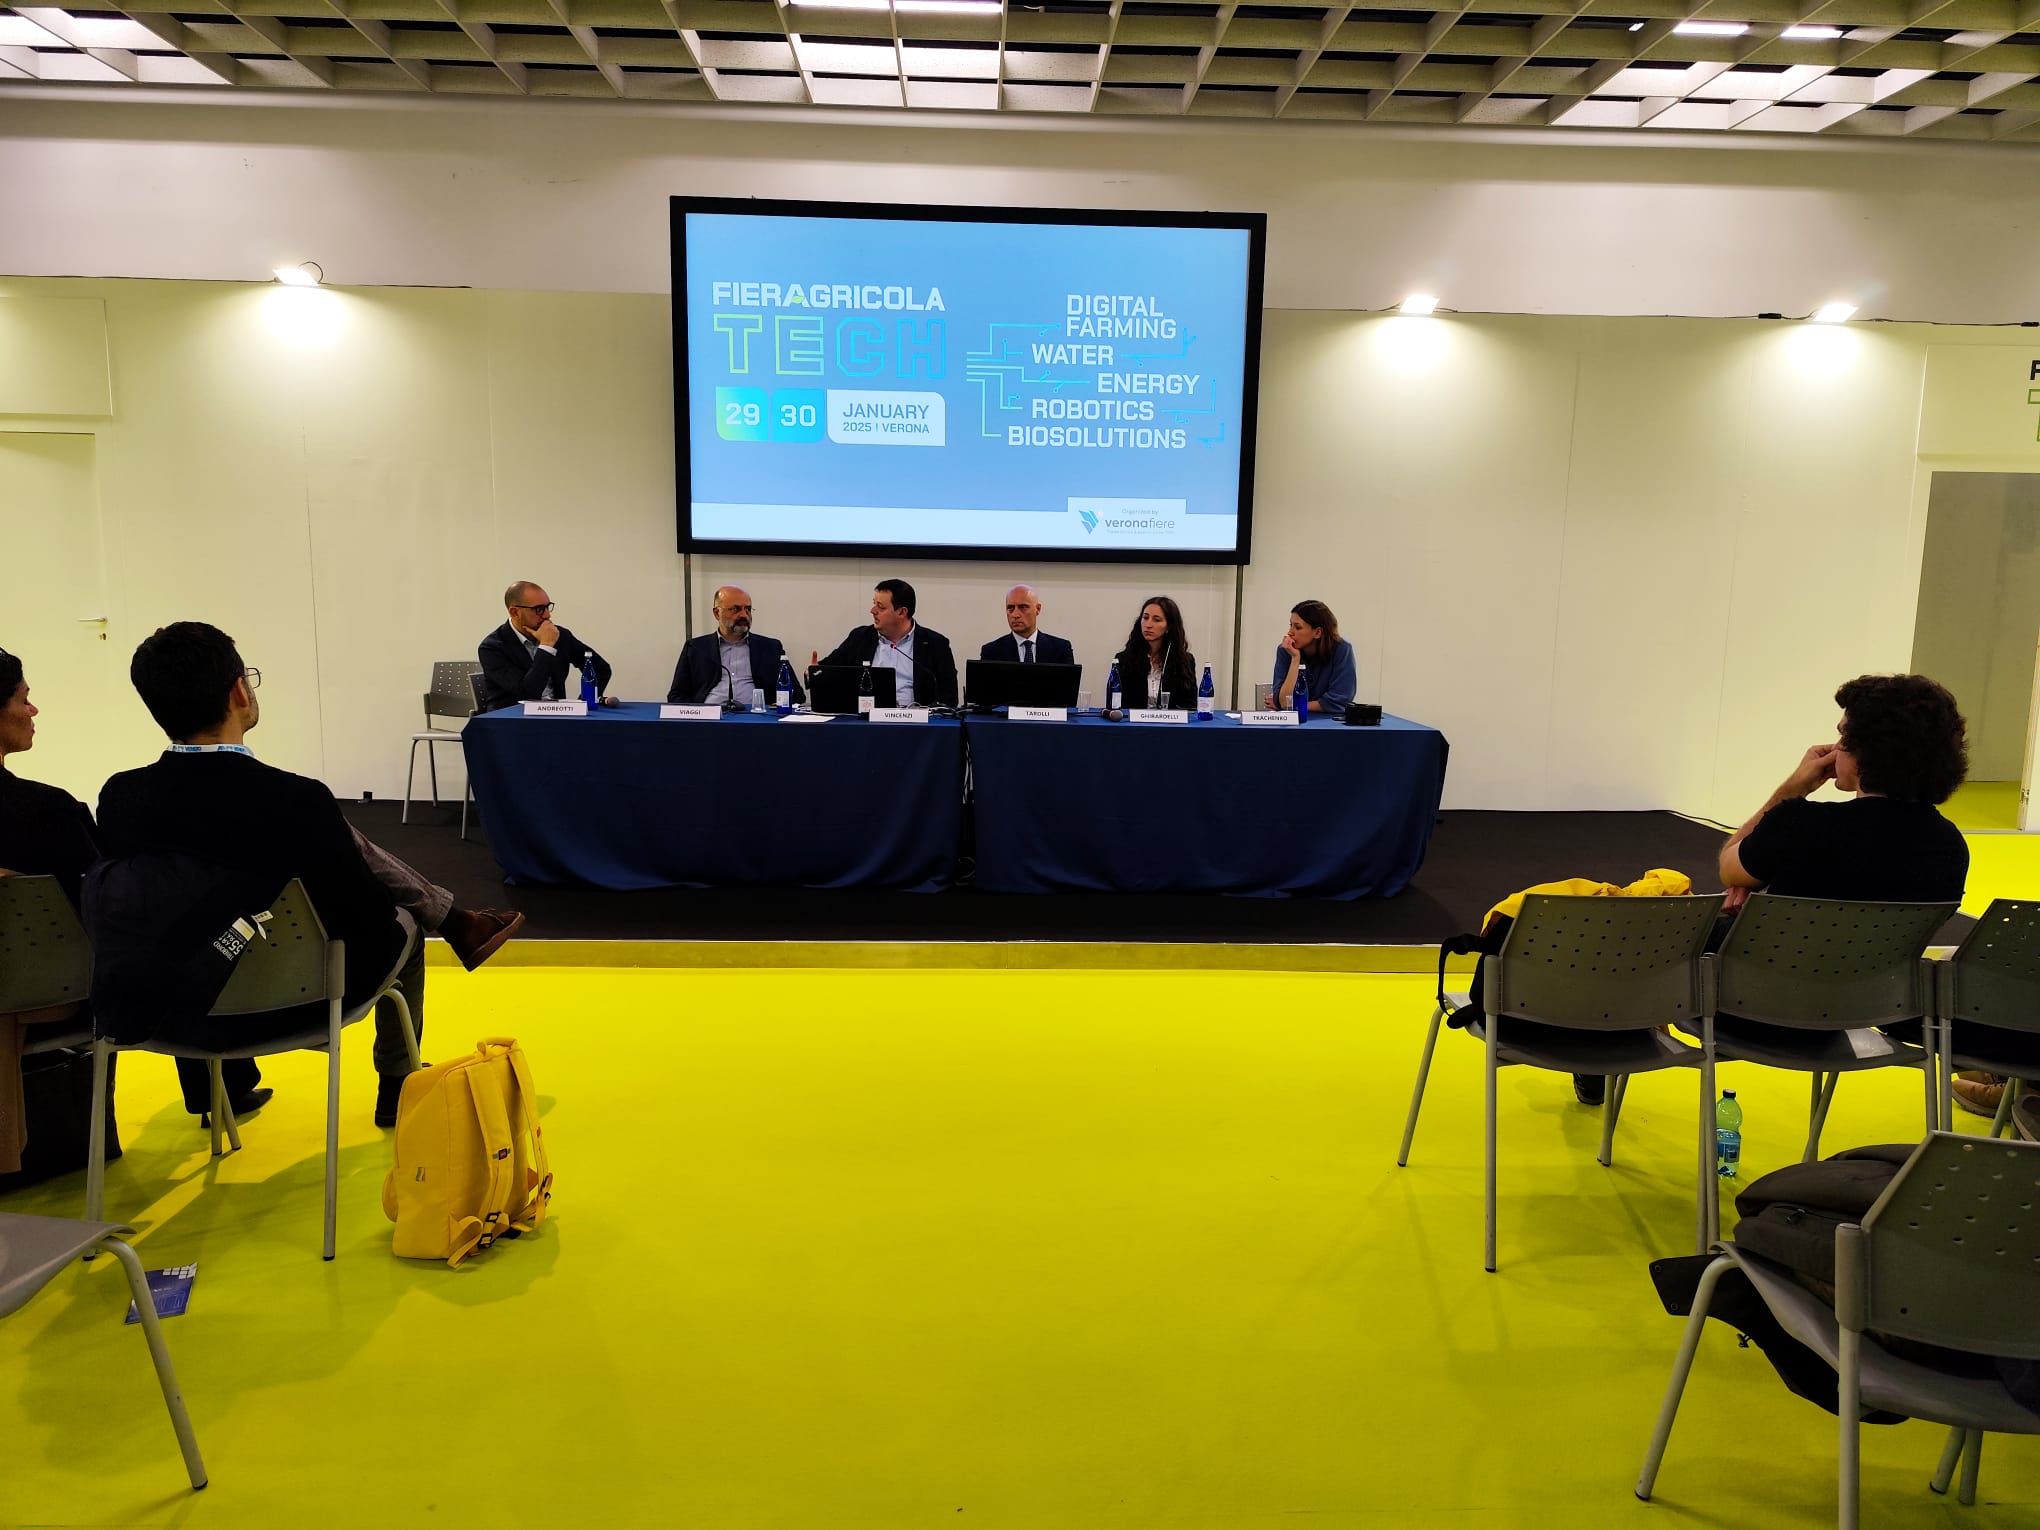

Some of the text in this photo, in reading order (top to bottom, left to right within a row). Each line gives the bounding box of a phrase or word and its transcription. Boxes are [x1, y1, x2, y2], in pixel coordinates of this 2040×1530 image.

[712, 281, 946, 312] FIERAGRICOLA
[1066, 294, 1164, 317] DIGITAL
[1066, 316, 1177, 339] FARMING
[713, 313, 946, 379] TECH
[1031, 343, 1114, 366] WATER
[1096, 372, 1201, 395] ENERGY
[725, 402, 817, 428] 29 30
[842, 402, 930, 420] JANUARY
[1031, 398, 1155, 421] ROBOTICS
[842, 421, 873, 432] 2025
[881, 423, 930, 434] VERONA
[1008, 425, 1187, 449] BIOSOLUTIONS
[1105, 518, 1176, 529] veronafiere
